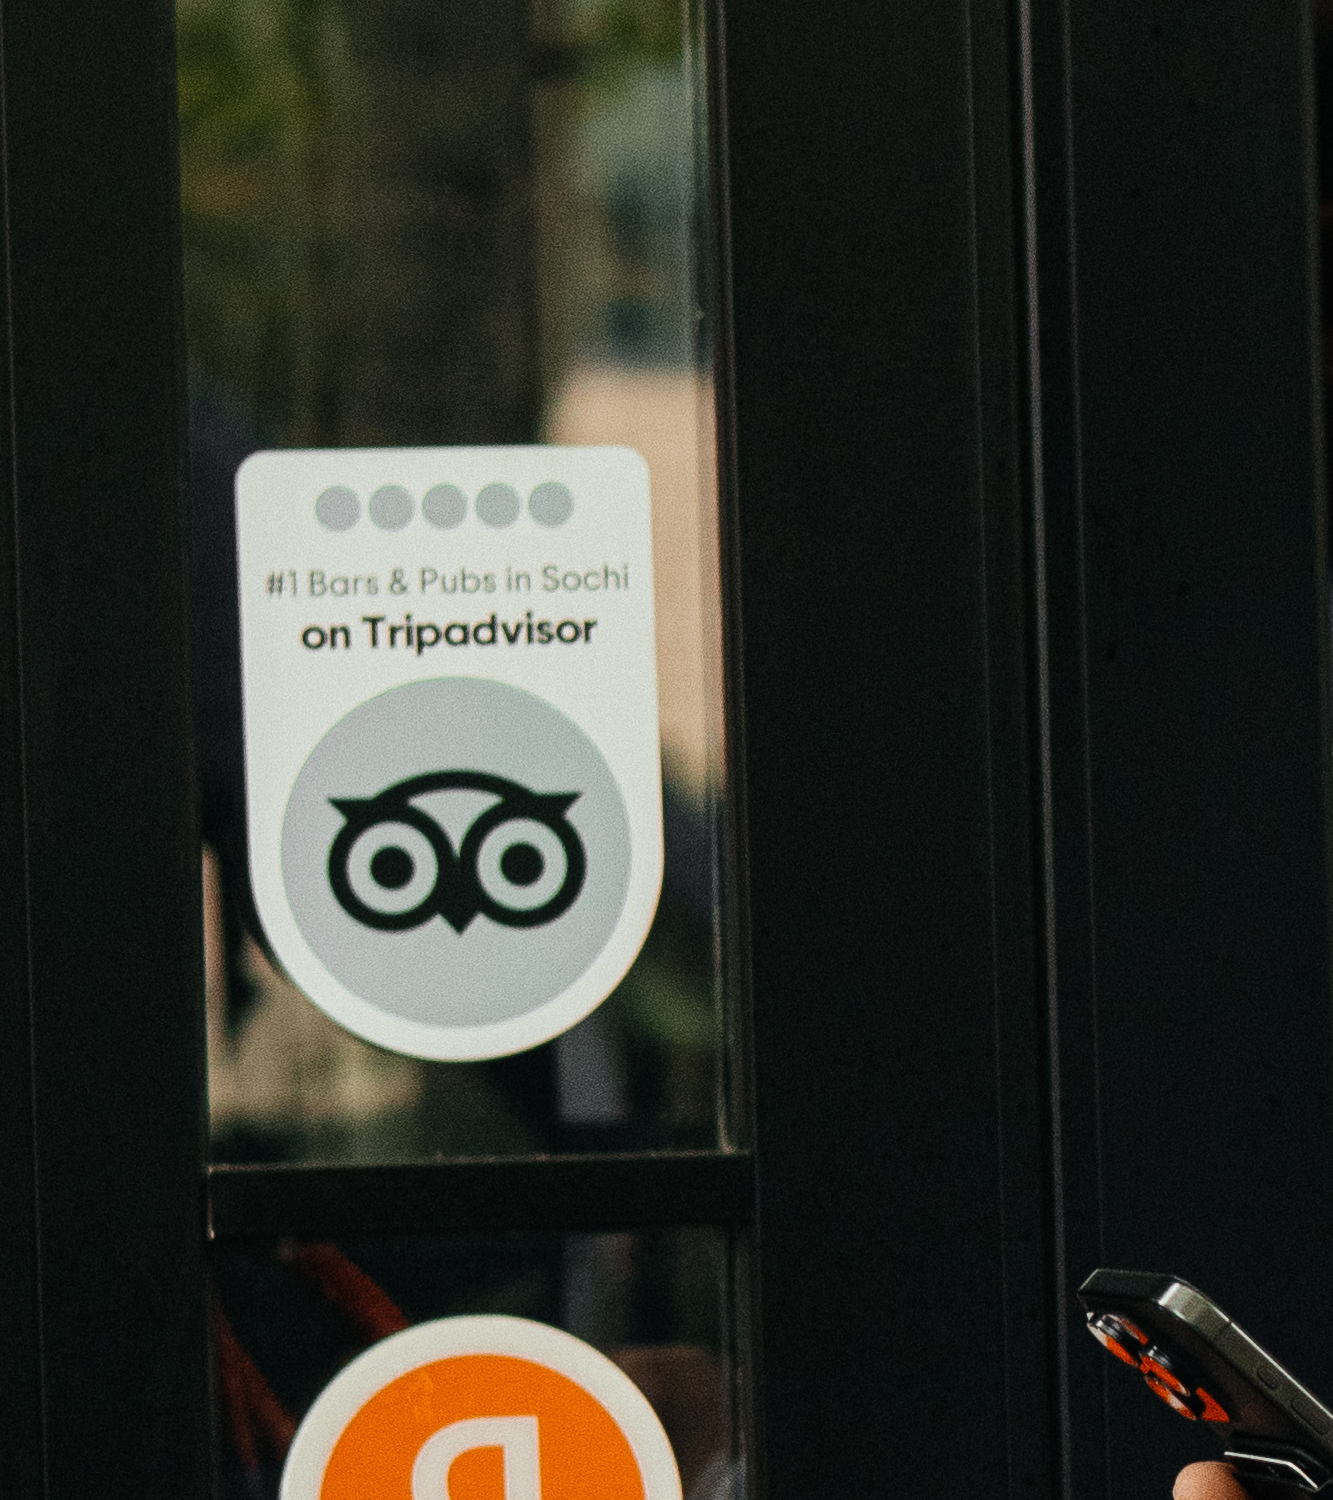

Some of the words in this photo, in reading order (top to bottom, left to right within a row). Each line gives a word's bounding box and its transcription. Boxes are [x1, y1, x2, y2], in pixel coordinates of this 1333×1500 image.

[265, 569, 298, 597] #1
[308, 568, 379, 597] Bars
[389, 567, 408, 595] &
[419, 566, 497, 594] Pubs
[506, 564, 532, 592] in
[543, 563, 630, 592] Sochi
[301, 624, 351, 649] on
[361, 609, 598, 656] Tripadvisor
